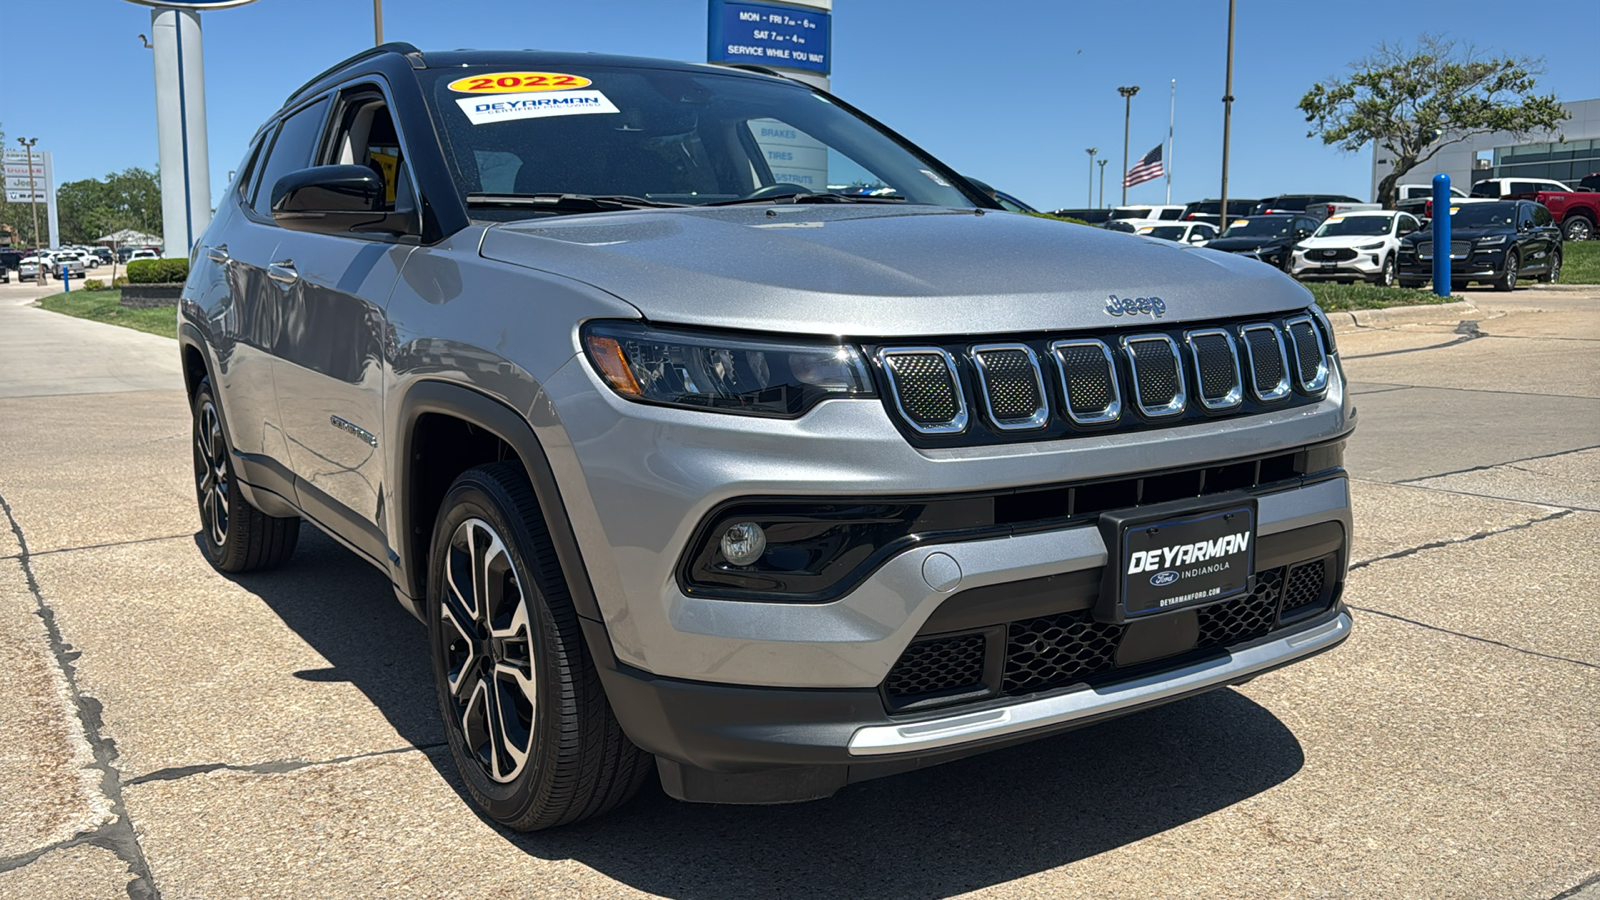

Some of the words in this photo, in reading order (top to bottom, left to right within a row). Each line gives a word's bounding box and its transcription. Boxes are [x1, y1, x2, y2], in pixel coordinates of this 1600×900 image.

[740, 11, 760, 22] MON
[769, 14, 782, 24] FRI
[753, 29, 769, 40] SAT
[727, 45, 764, 56] SERVICE
[766, 48, 790, 59] WHILE
[792, 51, 807, 61] YOU
[808, 53, 824, 63] WAIT
[468, 76, 578, 90] 2022
[475, 97, 599, 112] DEYARMAN
[487, 106, 541, 114] CERTIFIED
[761, 128, 797, 139] BRAKES
[768, 151, 793, 161] TIRES
[1105, 295, 1166, 318] Jeep
[1127, 531, 1250, 575] DEYARMAN
[1181, 561, 1230, 579] INDIANOLA
[1160, 587, 1221, 607] DEYARMANFORD.COM
